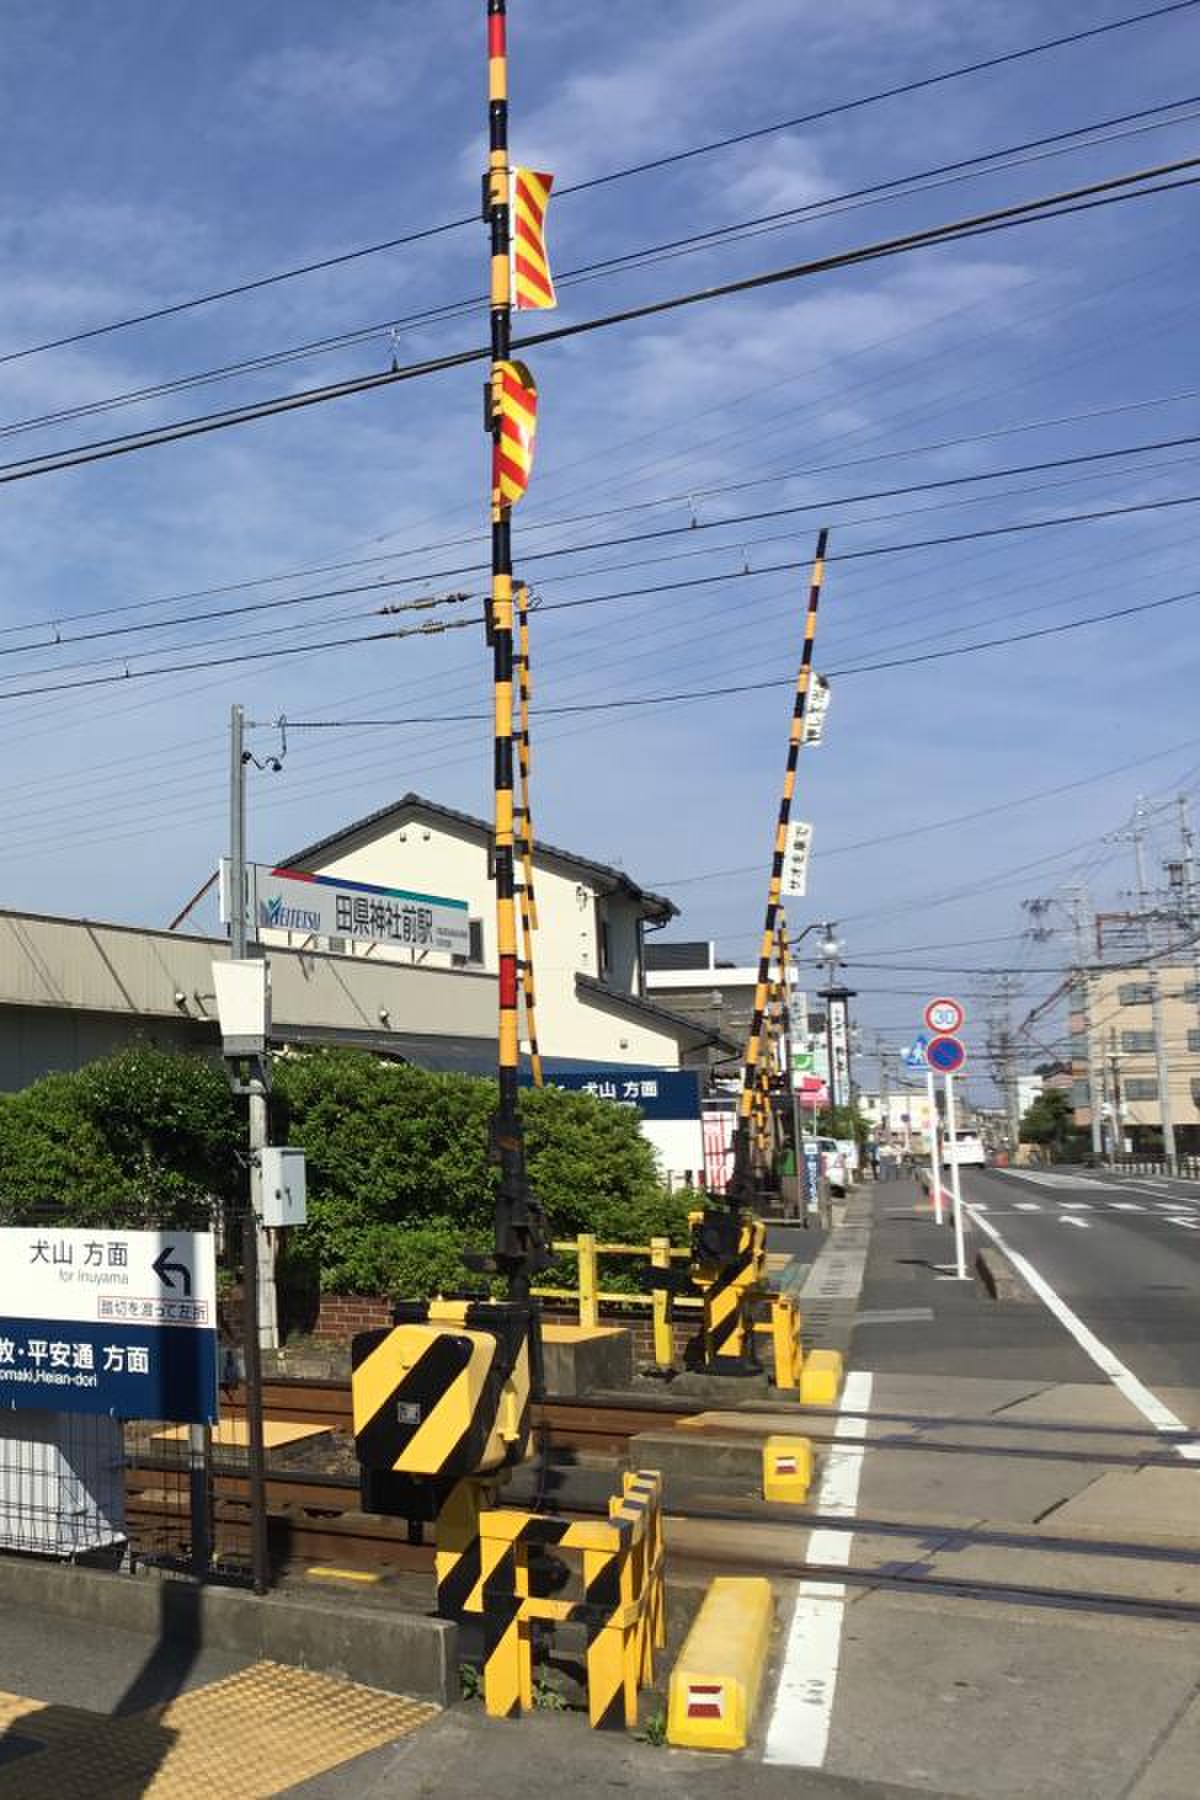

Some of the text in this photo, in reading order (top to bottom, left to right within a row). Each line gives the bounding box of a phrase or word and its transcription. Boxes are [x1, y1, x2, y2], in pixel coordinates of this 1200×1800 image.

[260, 896, 321, 931] MEITETSU
[334, 893, 434, 945] 田県神社前駅
[623, 1079, 658, 1098] 方面
[29, 1239, 129, 1268] 犬山 方面
[58, 1267, 129, 1286] for Inuyama
[102, 1345, 149, 1375] 方面
